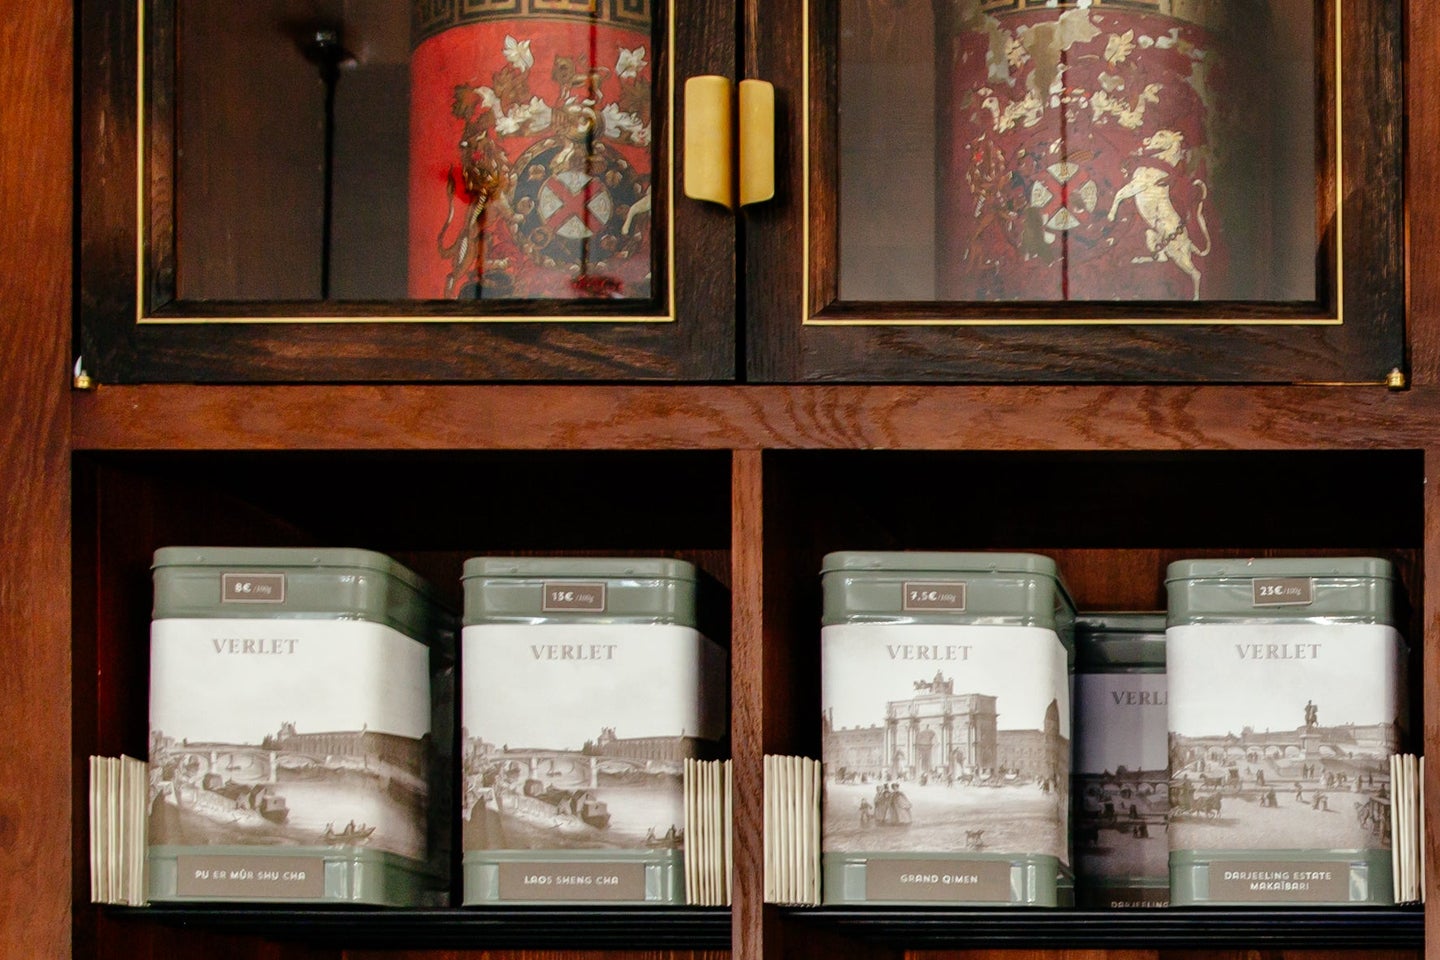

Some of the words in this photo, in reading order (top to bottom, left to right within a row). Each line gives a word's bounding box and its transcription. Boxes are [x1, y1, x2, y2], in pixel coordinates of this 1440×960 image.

[235, 583, 251, 593] 8€
[1260, 586, 1283, 596] 23€
[552, 592, 574, 602] 13€
[212, 639, 299, 654] VERLET
[1234, 644, 1322, 659] VERLET
[530, 645, 617, 660] VERLET
[885, 645, 972, 660] VERLET
[195, 870, 209, 879] PU
[213, 871, 226, 879] ER
[258, 872, 279, 880] SHU
[283, 872, 305, 880] CHA
[524, 876, 552, 884] LAOS
[556, 876, 592, 884] SHENG
[596, 876, 618, 884] CHA
[901, 875, 938, 883] GRAND
[942, 875, 977, 884] QIMEN
